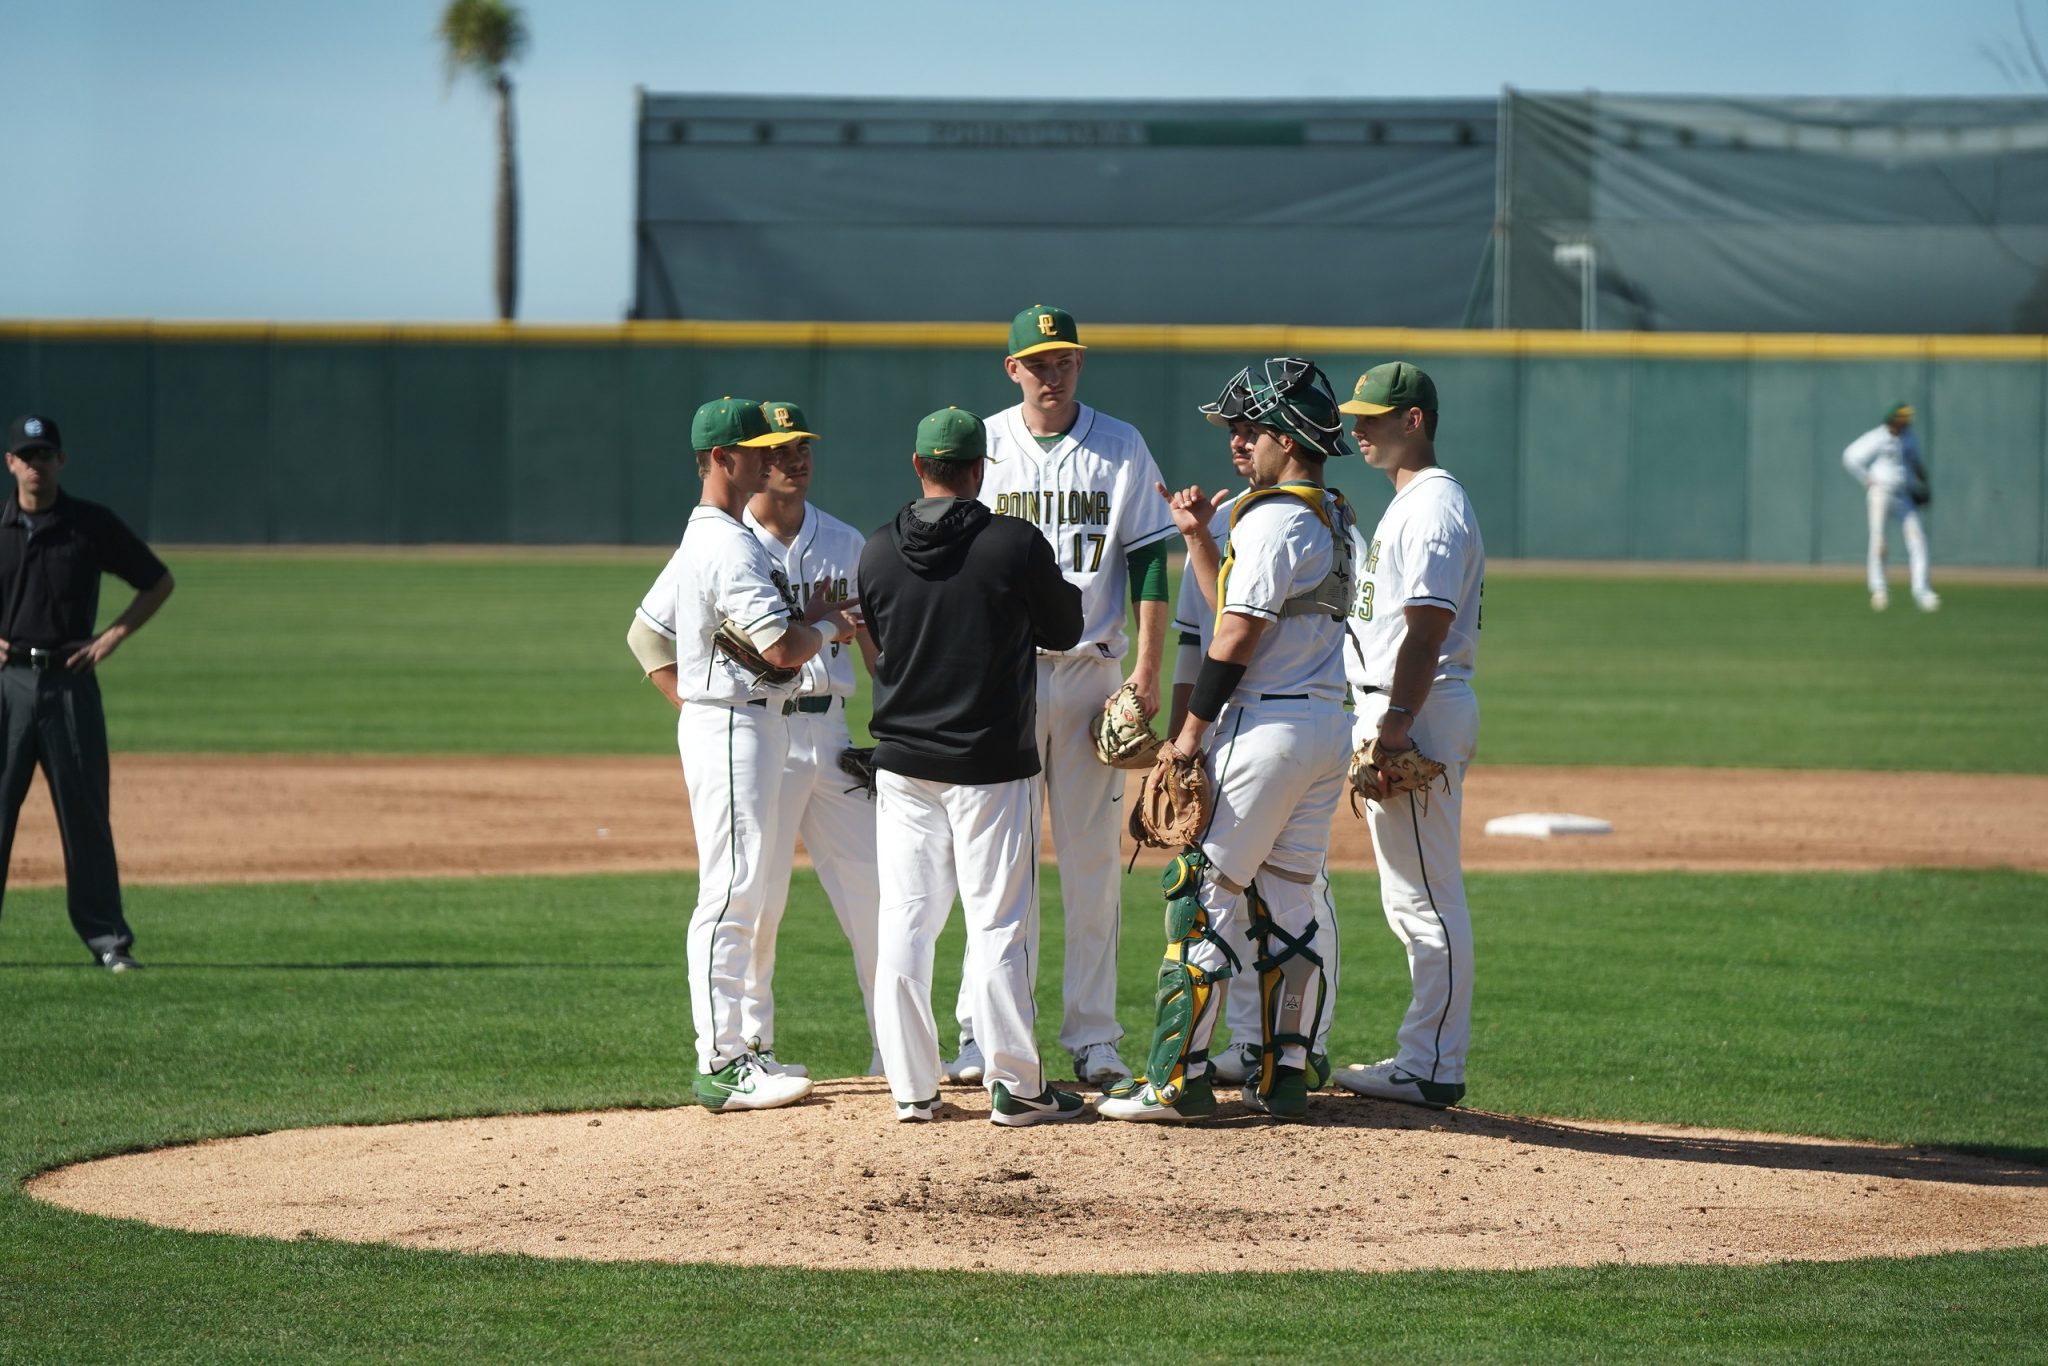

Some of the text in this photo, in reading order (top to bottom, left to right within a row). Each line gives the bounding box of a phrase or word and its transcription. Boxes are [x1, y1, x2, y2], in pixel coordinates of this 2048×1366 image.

[995, 490, 1111, 525] POINT LOMA
[1074, 533, 1107, 572] 17
